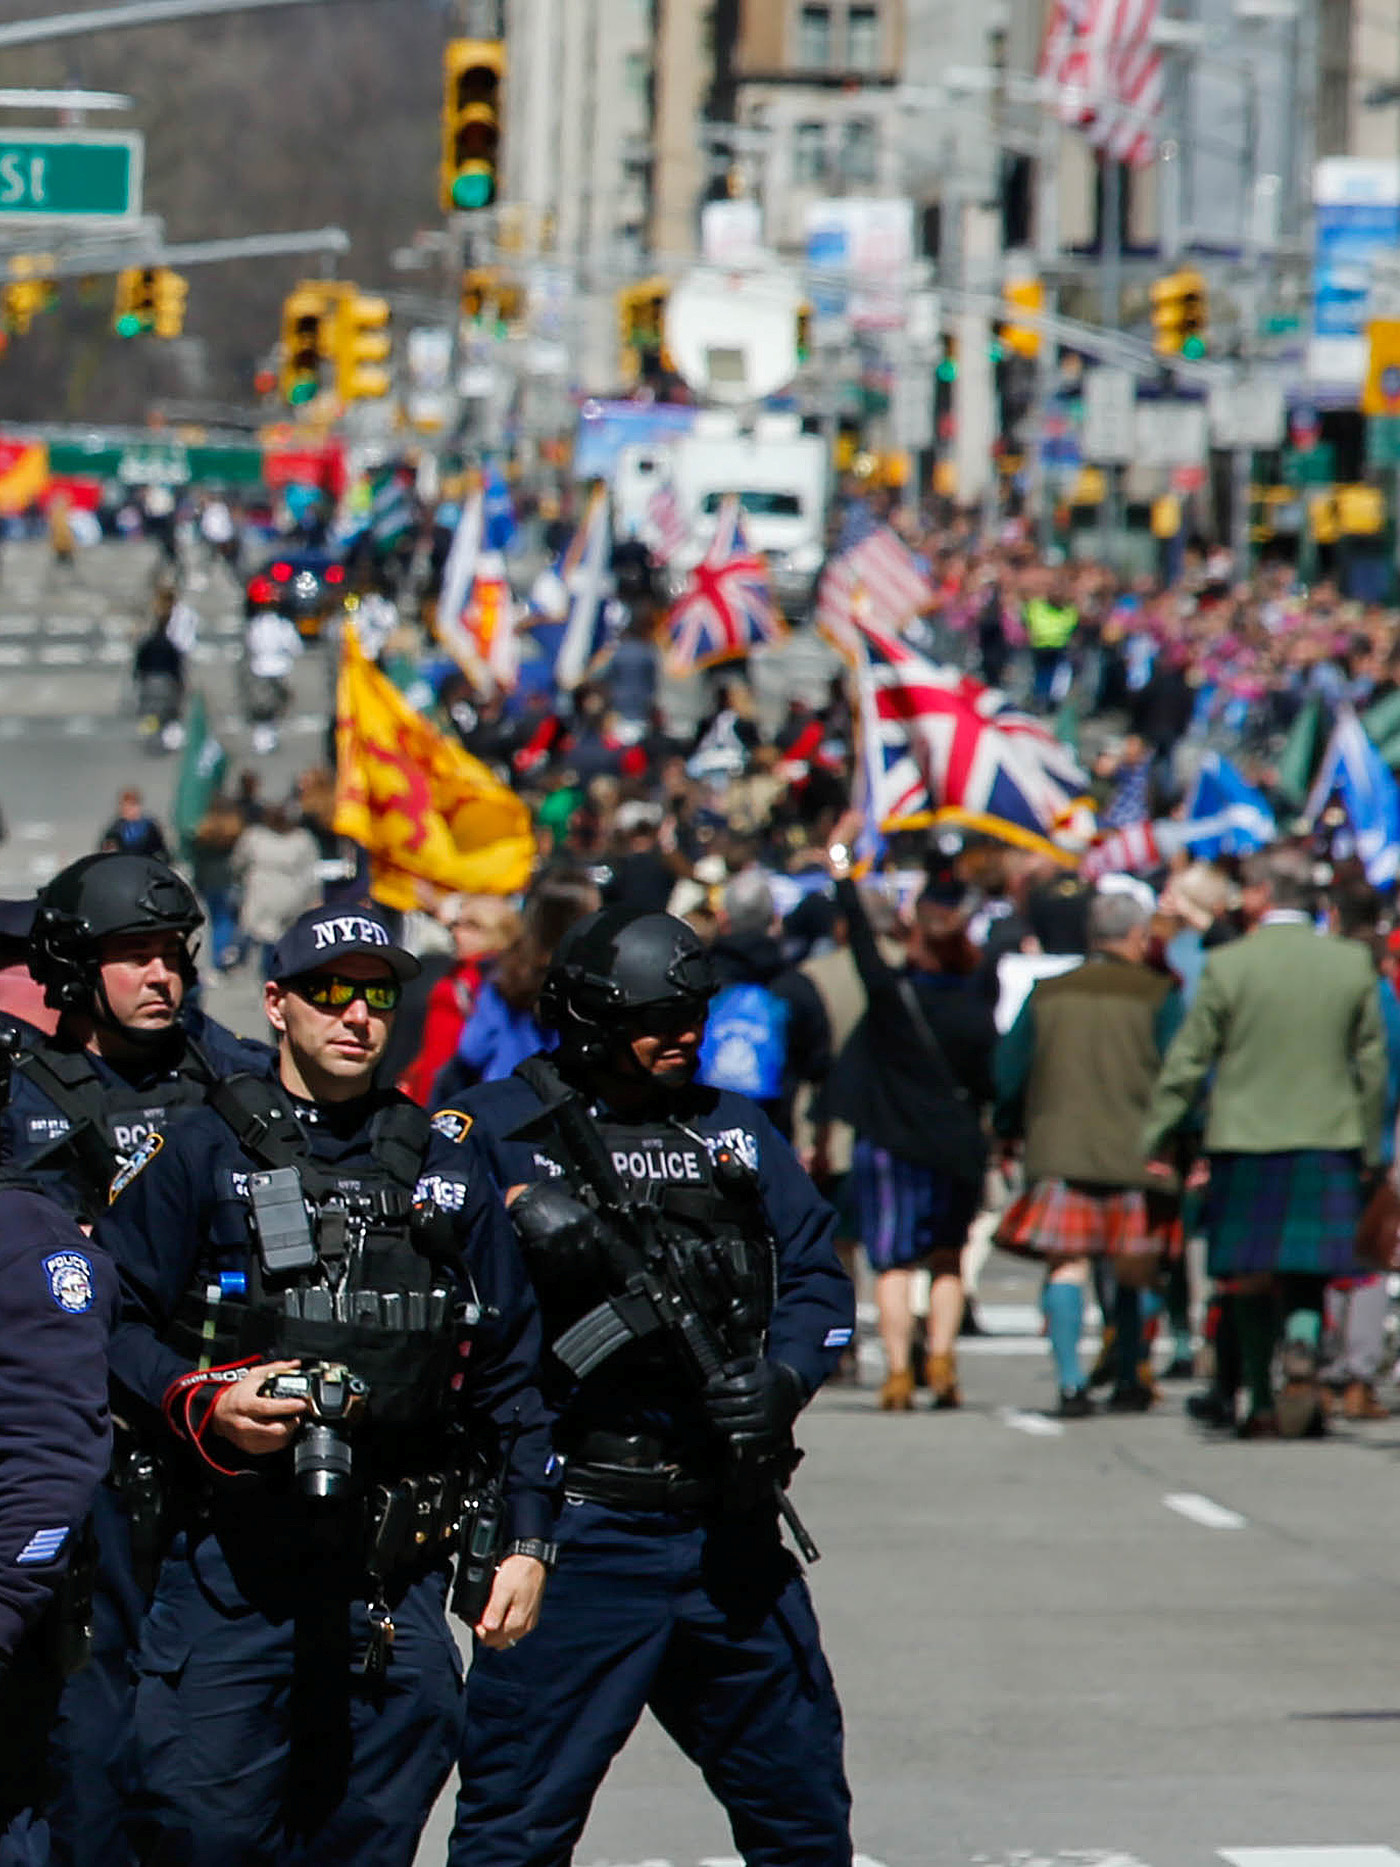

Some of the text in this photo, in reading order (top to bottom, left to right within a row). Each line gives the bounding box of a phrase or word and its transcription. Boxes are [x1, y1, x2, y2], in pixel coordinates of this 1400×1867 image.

[0, 152, 46, 202] St
[312, 916, 389, 949] NYPD
[611, 1151, 701, 1180] POLICE
[47, 1255, 90, 1276] POLICE
